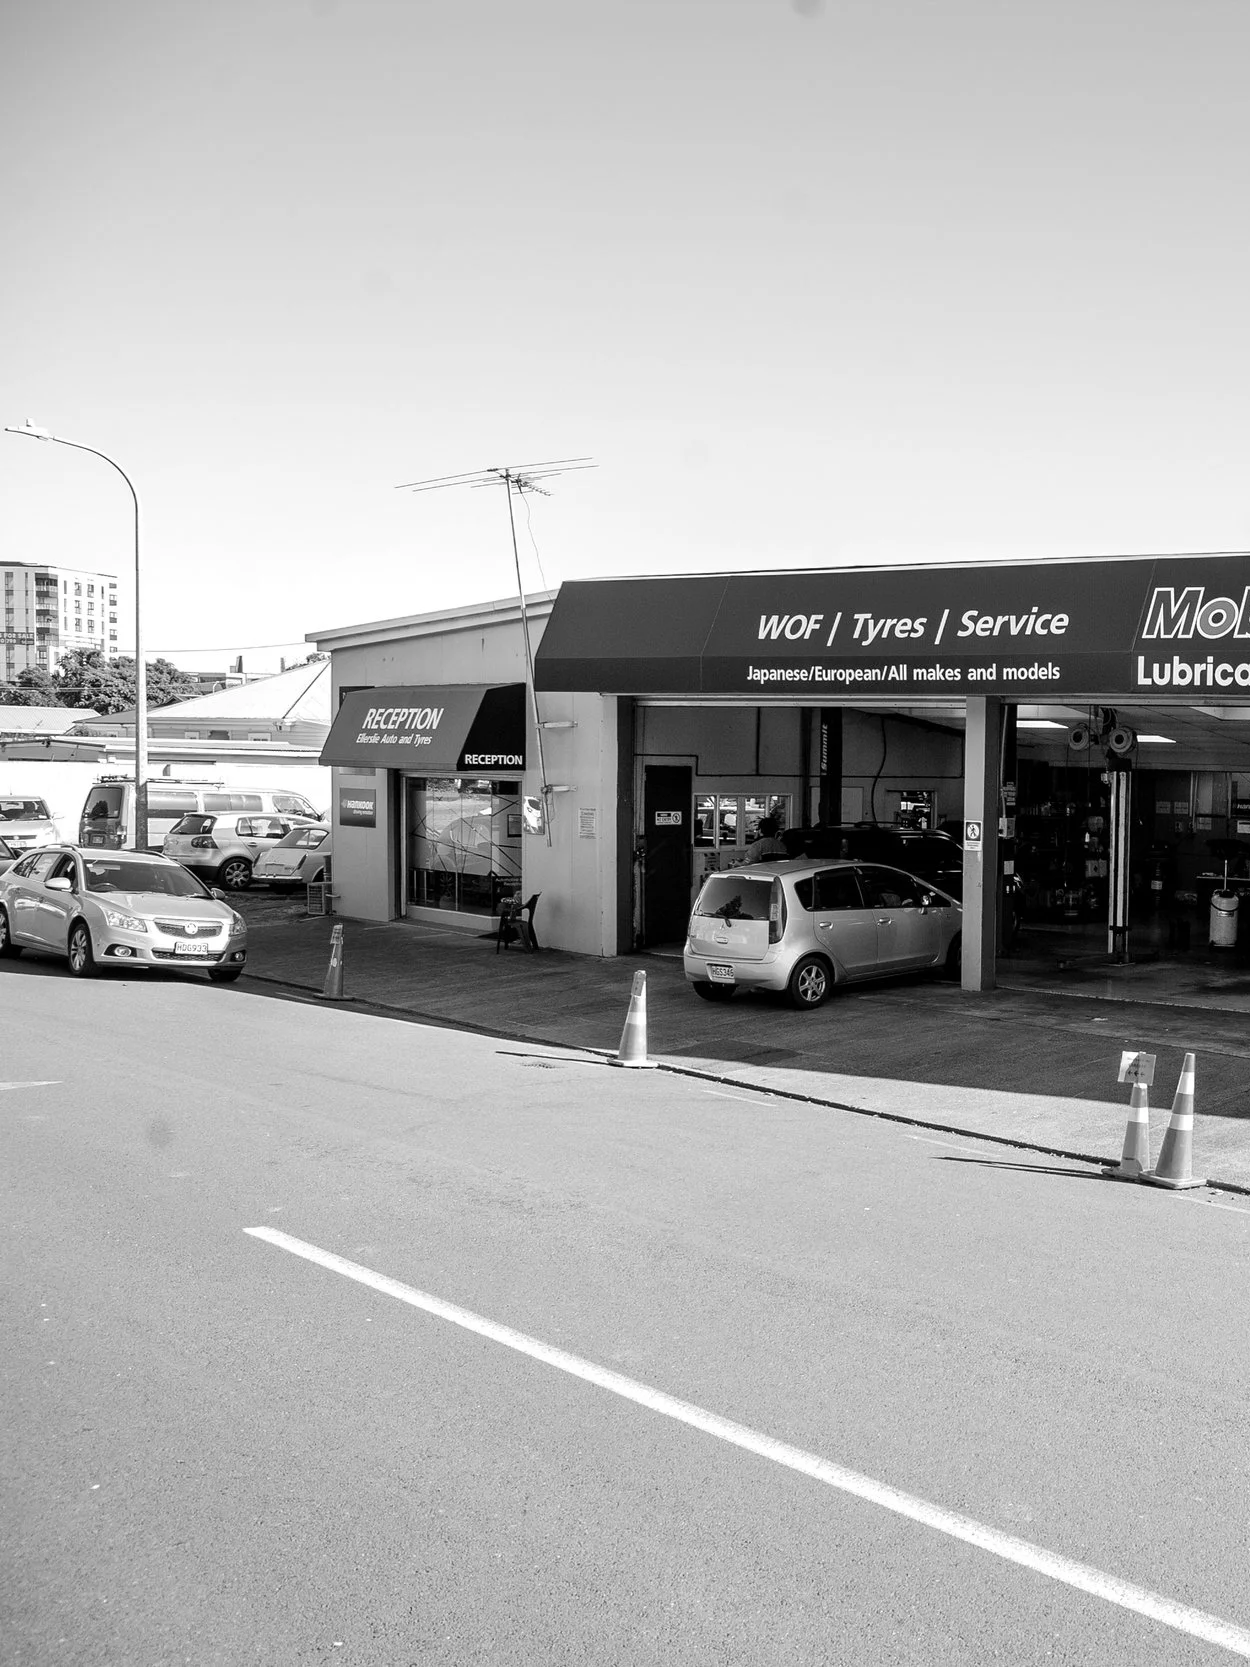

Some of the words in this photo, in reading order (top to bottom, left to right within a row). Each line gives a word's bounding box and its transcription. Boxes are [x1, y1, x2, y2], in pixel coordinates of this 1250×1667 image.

[757, 614, 824, 640] WOF
[852, 613, 927, 646] Tyres
[956, 606, 1070, 637] Service
[746, 663, 908, 685] Japanese/European/All
[912, 663, 962, 681] makes
[967, 662, 997, 681] and
[1002, 661, 1061, 681] models
[361, 707, 445, 730] RECEPTION
[355, 733, 380, 744] Ellerslie
[381, 733, 398, 744] Auto
[398, 734, 414, 744] and
[413, 734, 433, 748] Tyres
[464, 753, 523, 766] RECEPTION
